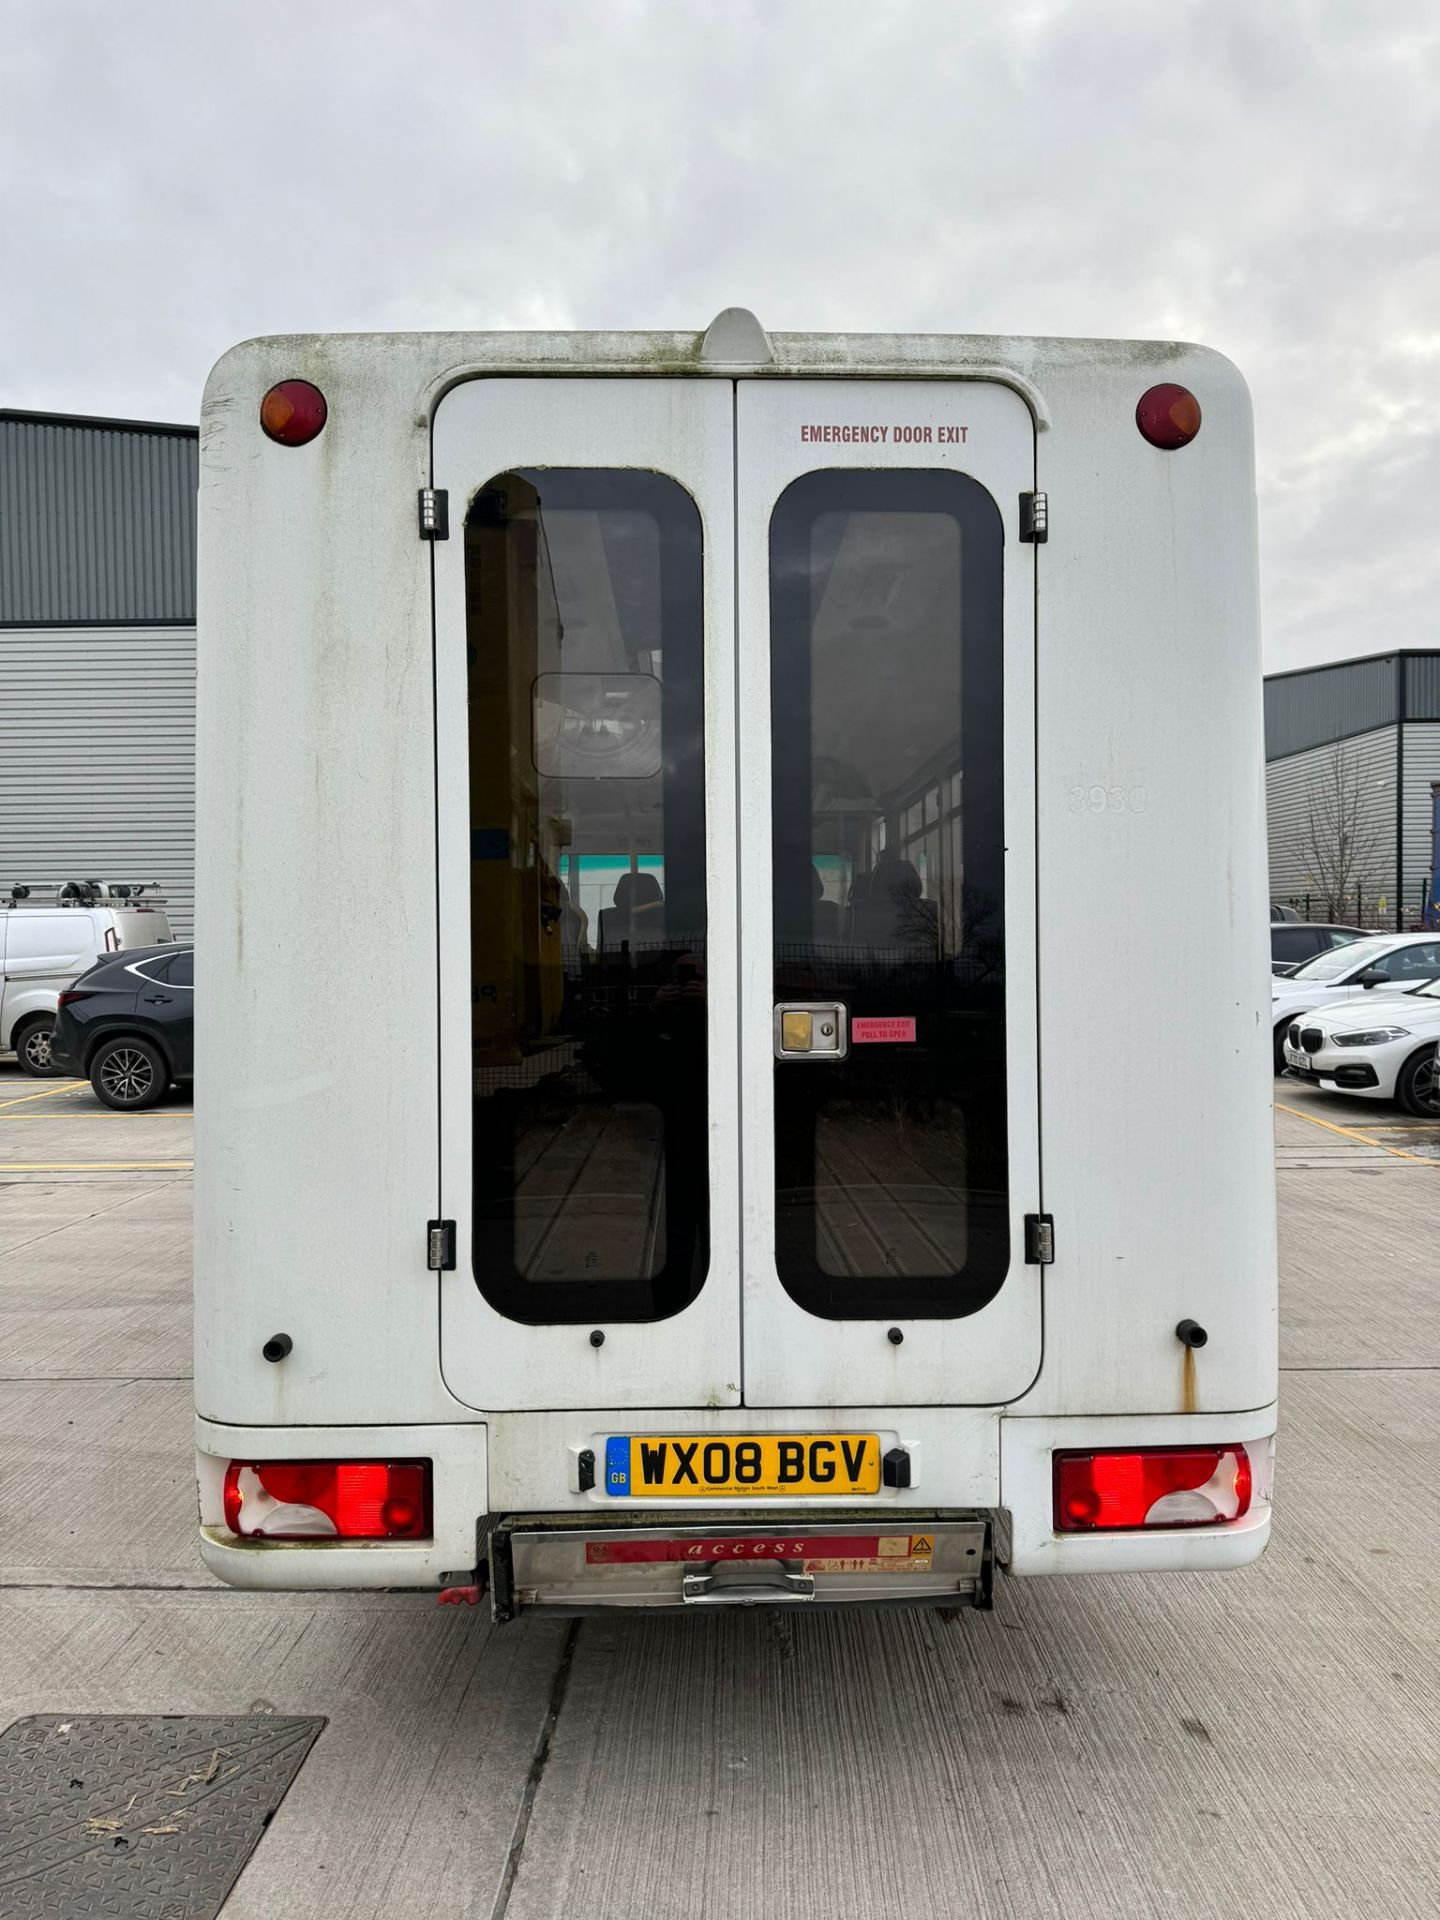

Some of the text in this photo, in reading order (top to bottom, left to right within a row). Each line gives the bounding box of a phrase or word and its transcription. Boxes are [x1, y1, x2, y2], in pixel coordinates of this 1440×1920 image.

[800, 425, 969, 443] EMERGENCY DOOR EXIT
[856, 1020, 911, 1029] EMERGENCY EXIT
[878, 1030, 888, 1038] TO
[889, 1030, 906, 1038] OPEN
[640, 1440, 867, 1485] WX08 BGV
[611, 1472, 626, 1484] GB
[688, 1542, 805, 1555] access
